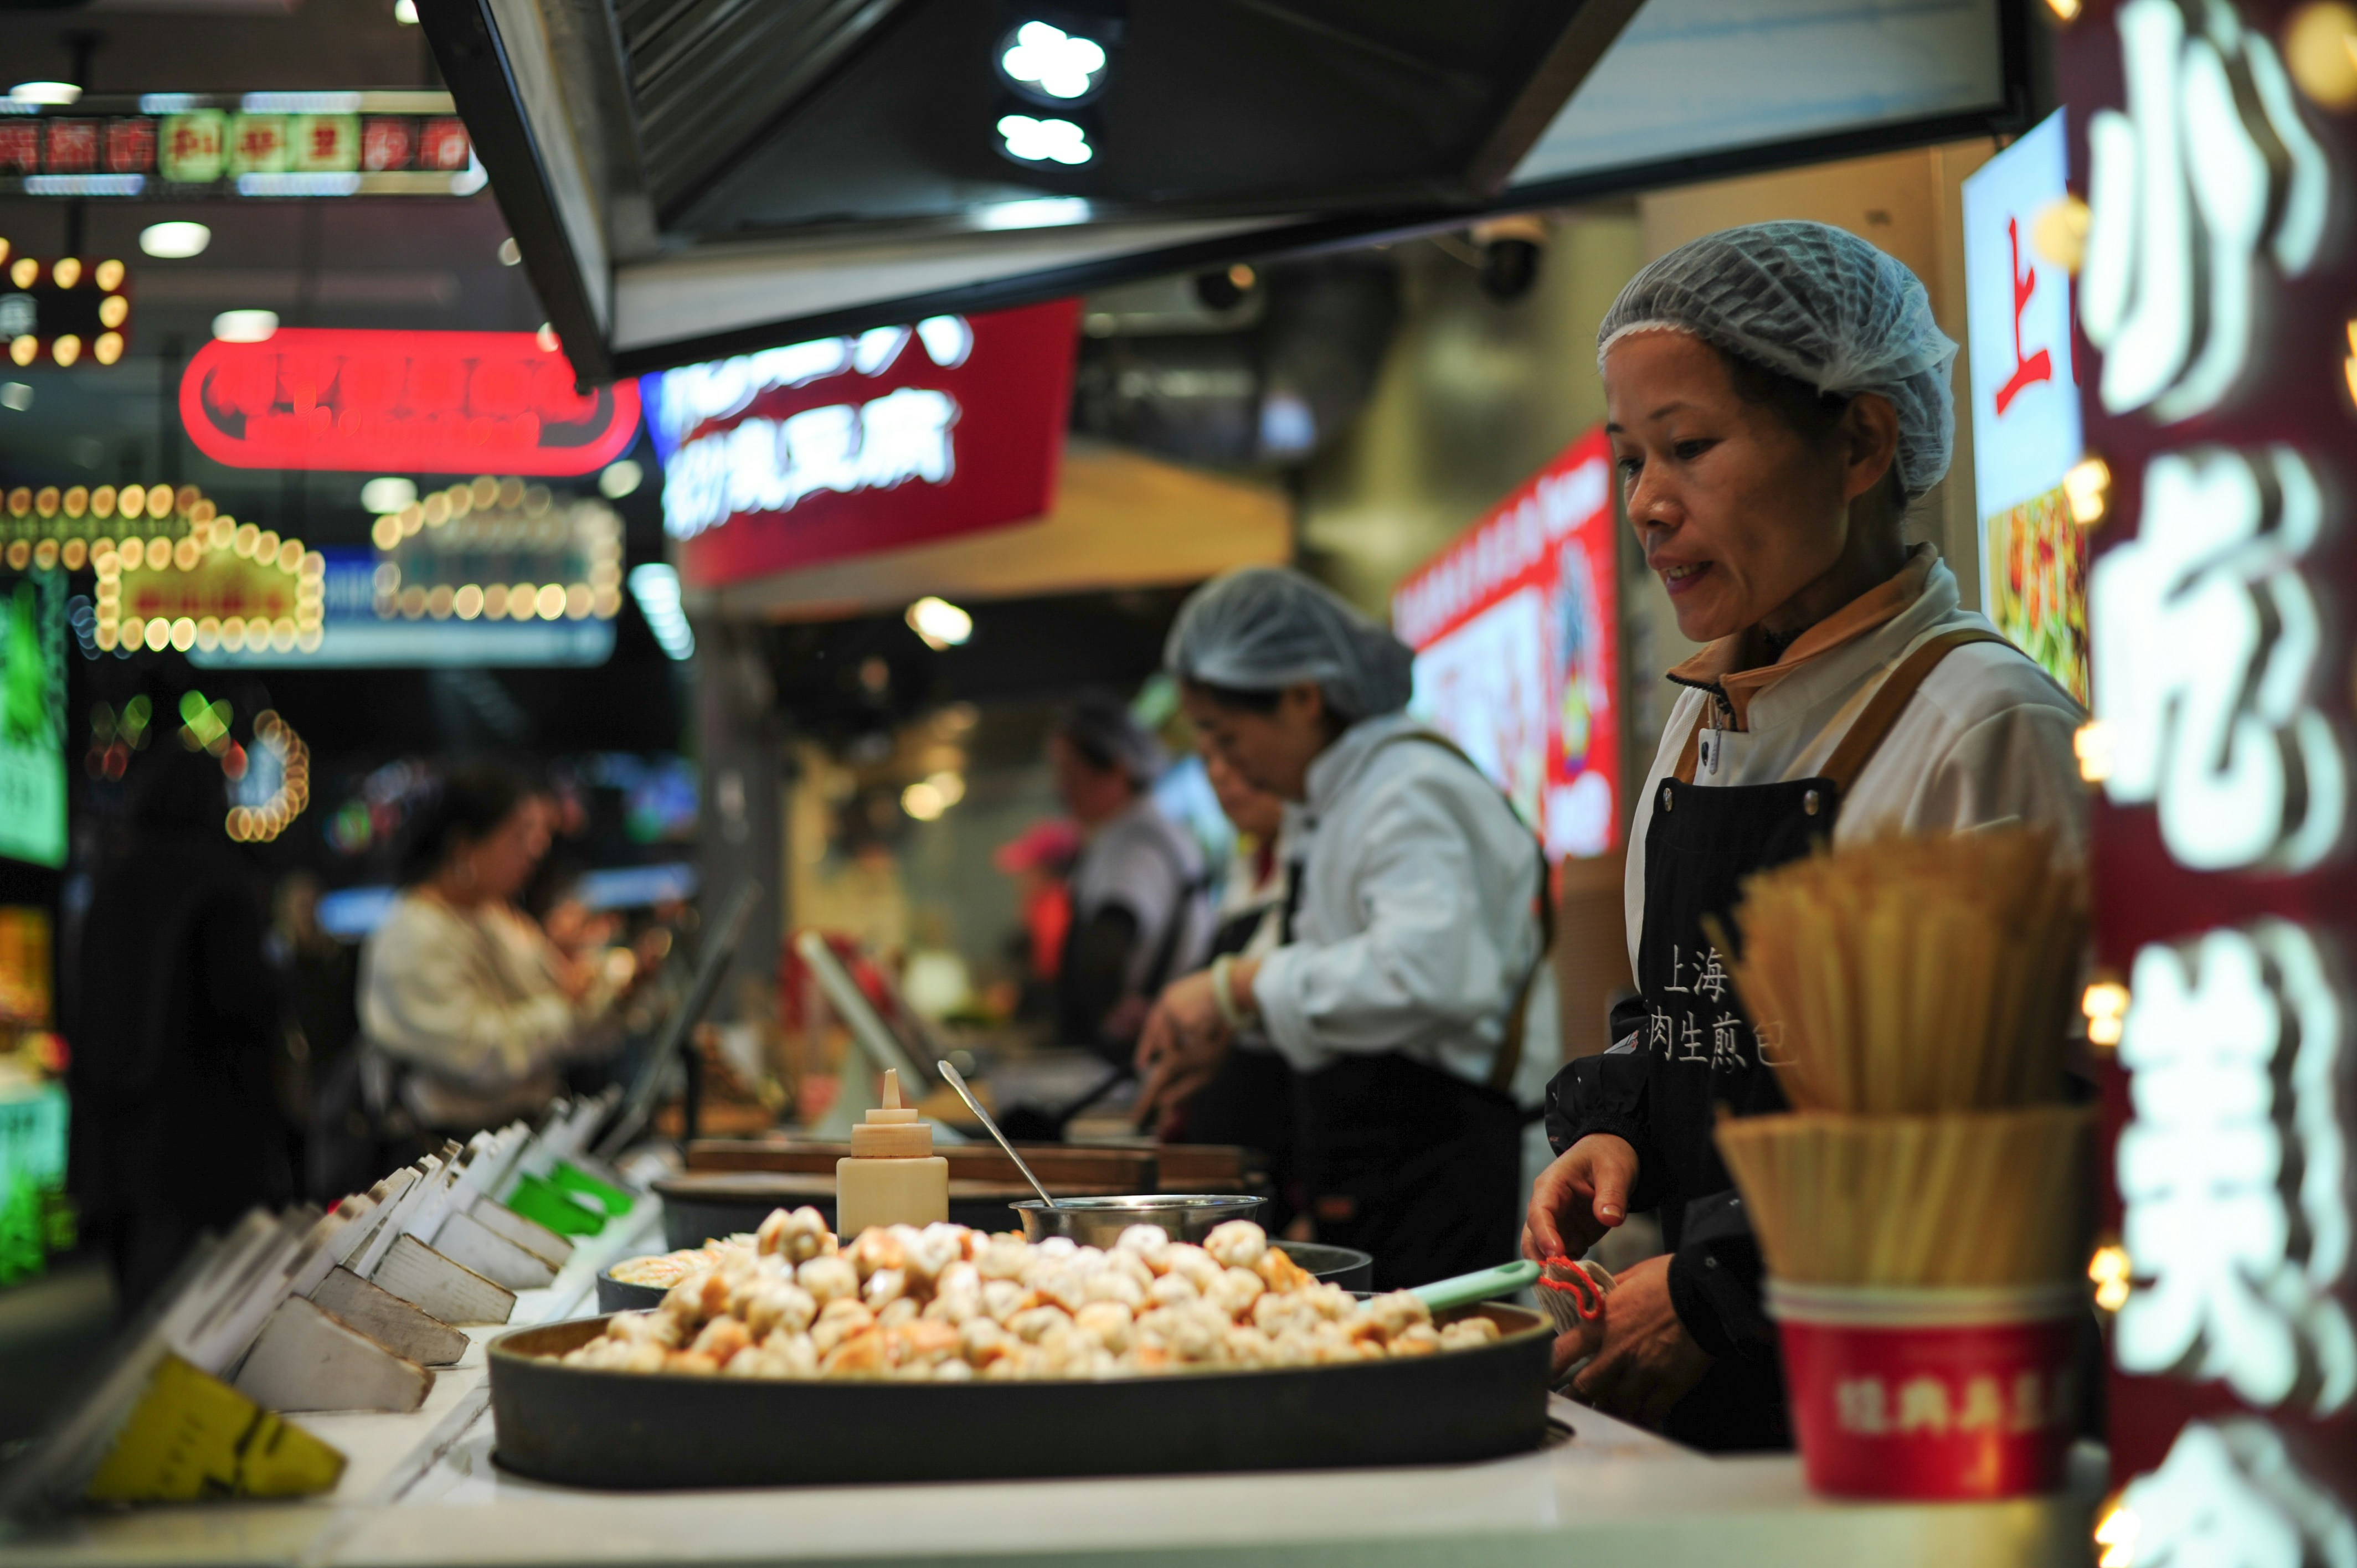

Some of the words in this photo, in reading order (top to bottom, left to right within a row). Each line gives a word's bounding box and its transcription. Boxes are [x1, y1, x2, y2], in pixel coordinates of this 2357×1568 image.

[1995, 216, 2052, 419] 上
[1664, 944, 1728, 1003] 上海
[1649, 1005, 1798, 1073] 肉生煎包
